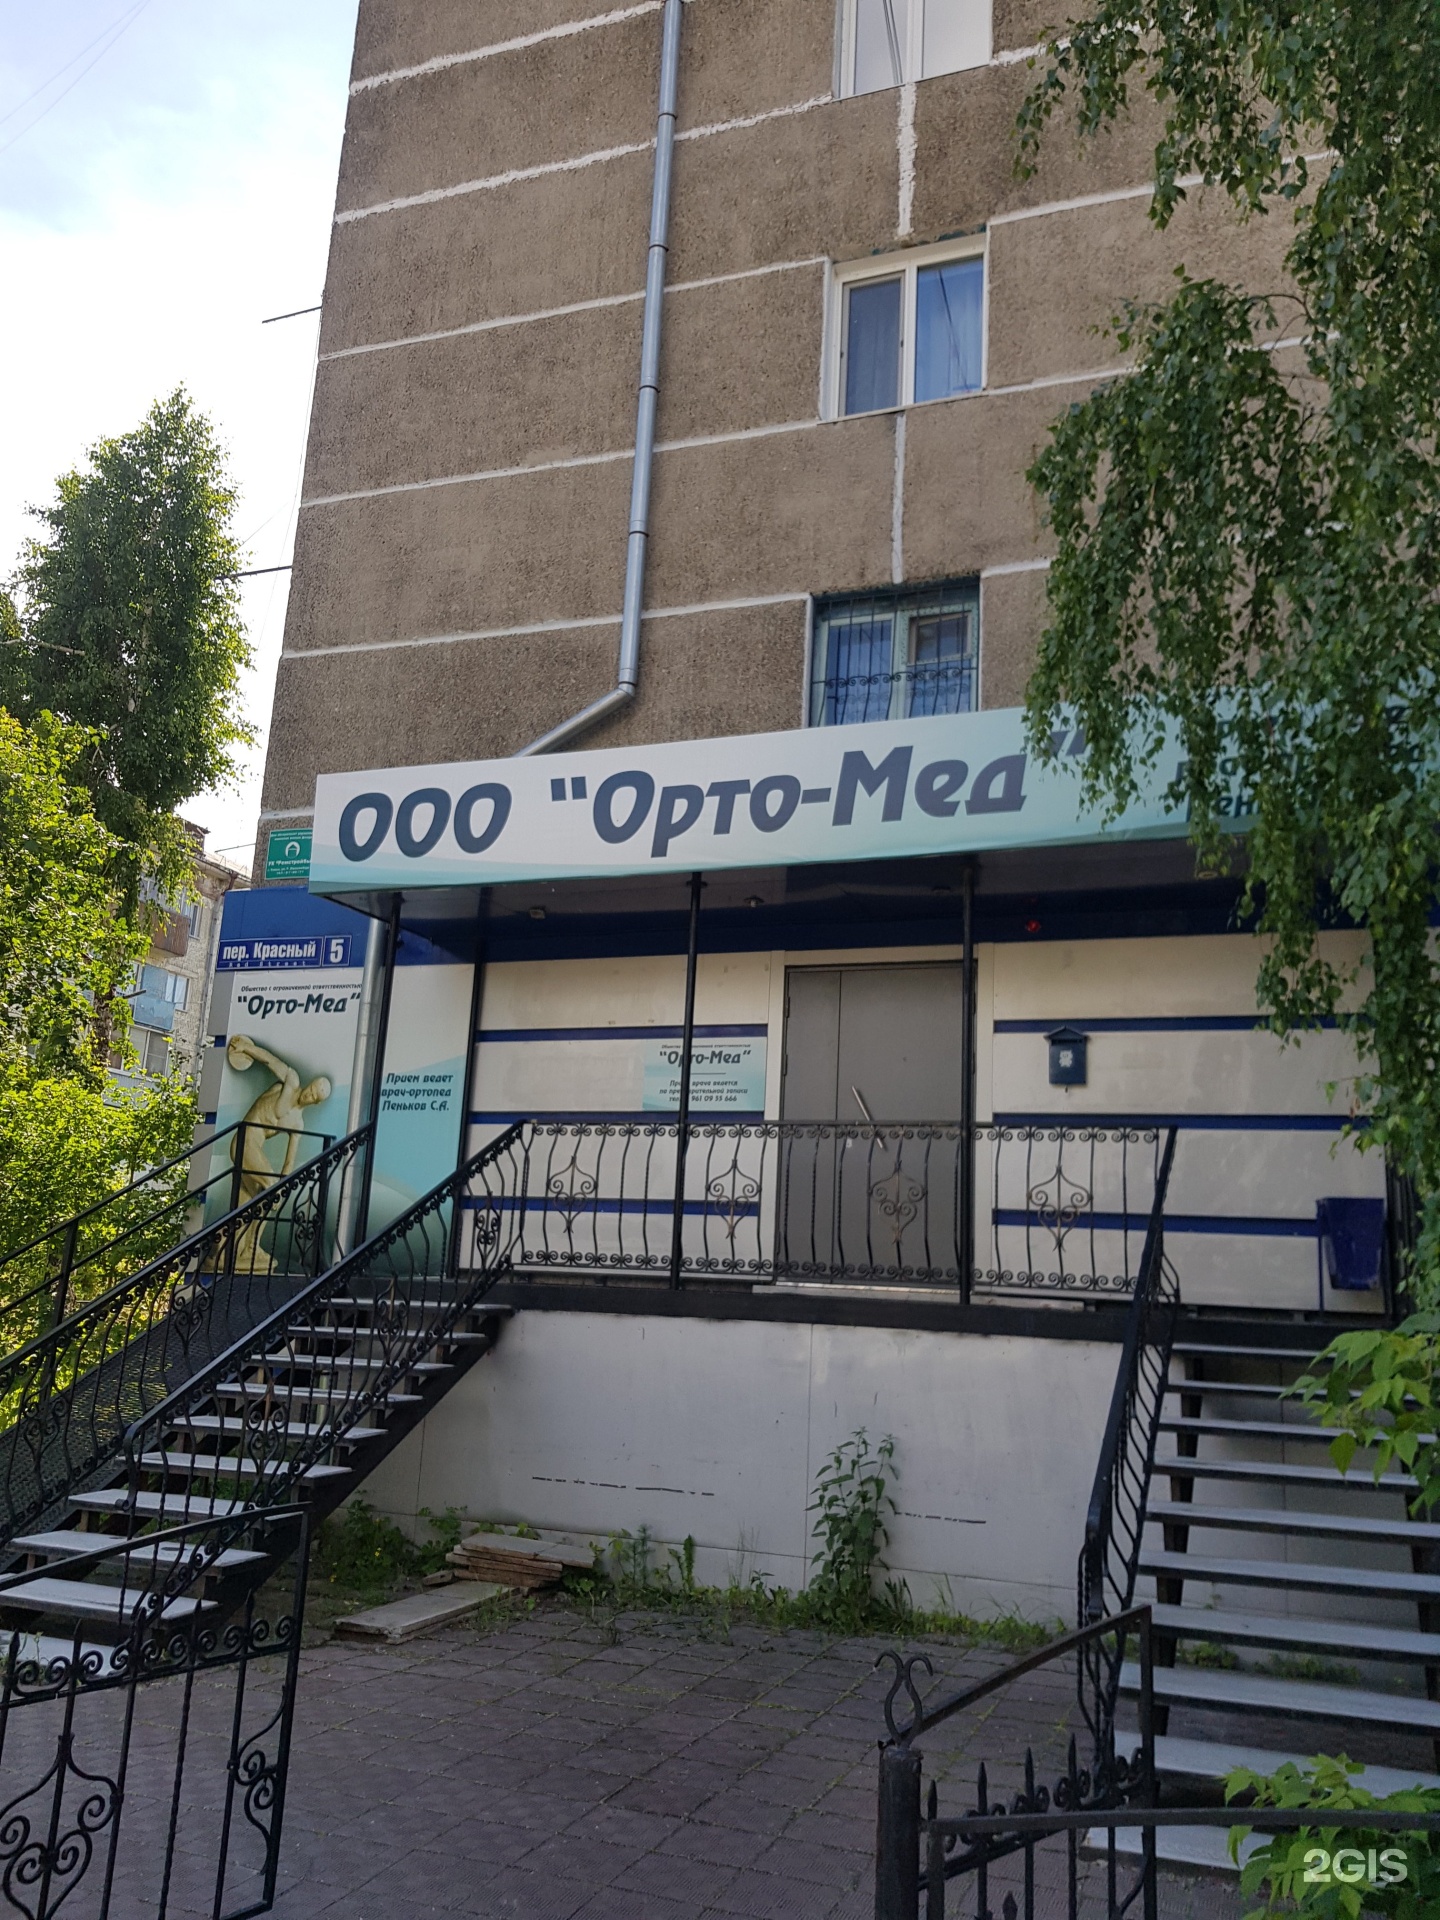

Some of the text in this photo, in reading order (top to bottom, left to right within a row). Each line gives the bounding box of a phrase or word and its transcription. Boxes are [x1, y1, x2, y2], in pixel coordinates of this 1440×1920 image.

[339, 782, 512, 862] ООО
[222, 938, 345, 963] пер. Красный 5
[386, 1072, 454, 1085] Прием ведет
[381, 1088, 452, 1099] врач-ортопед
[382, 1100, 450, 1111] Пеньков С.А.
